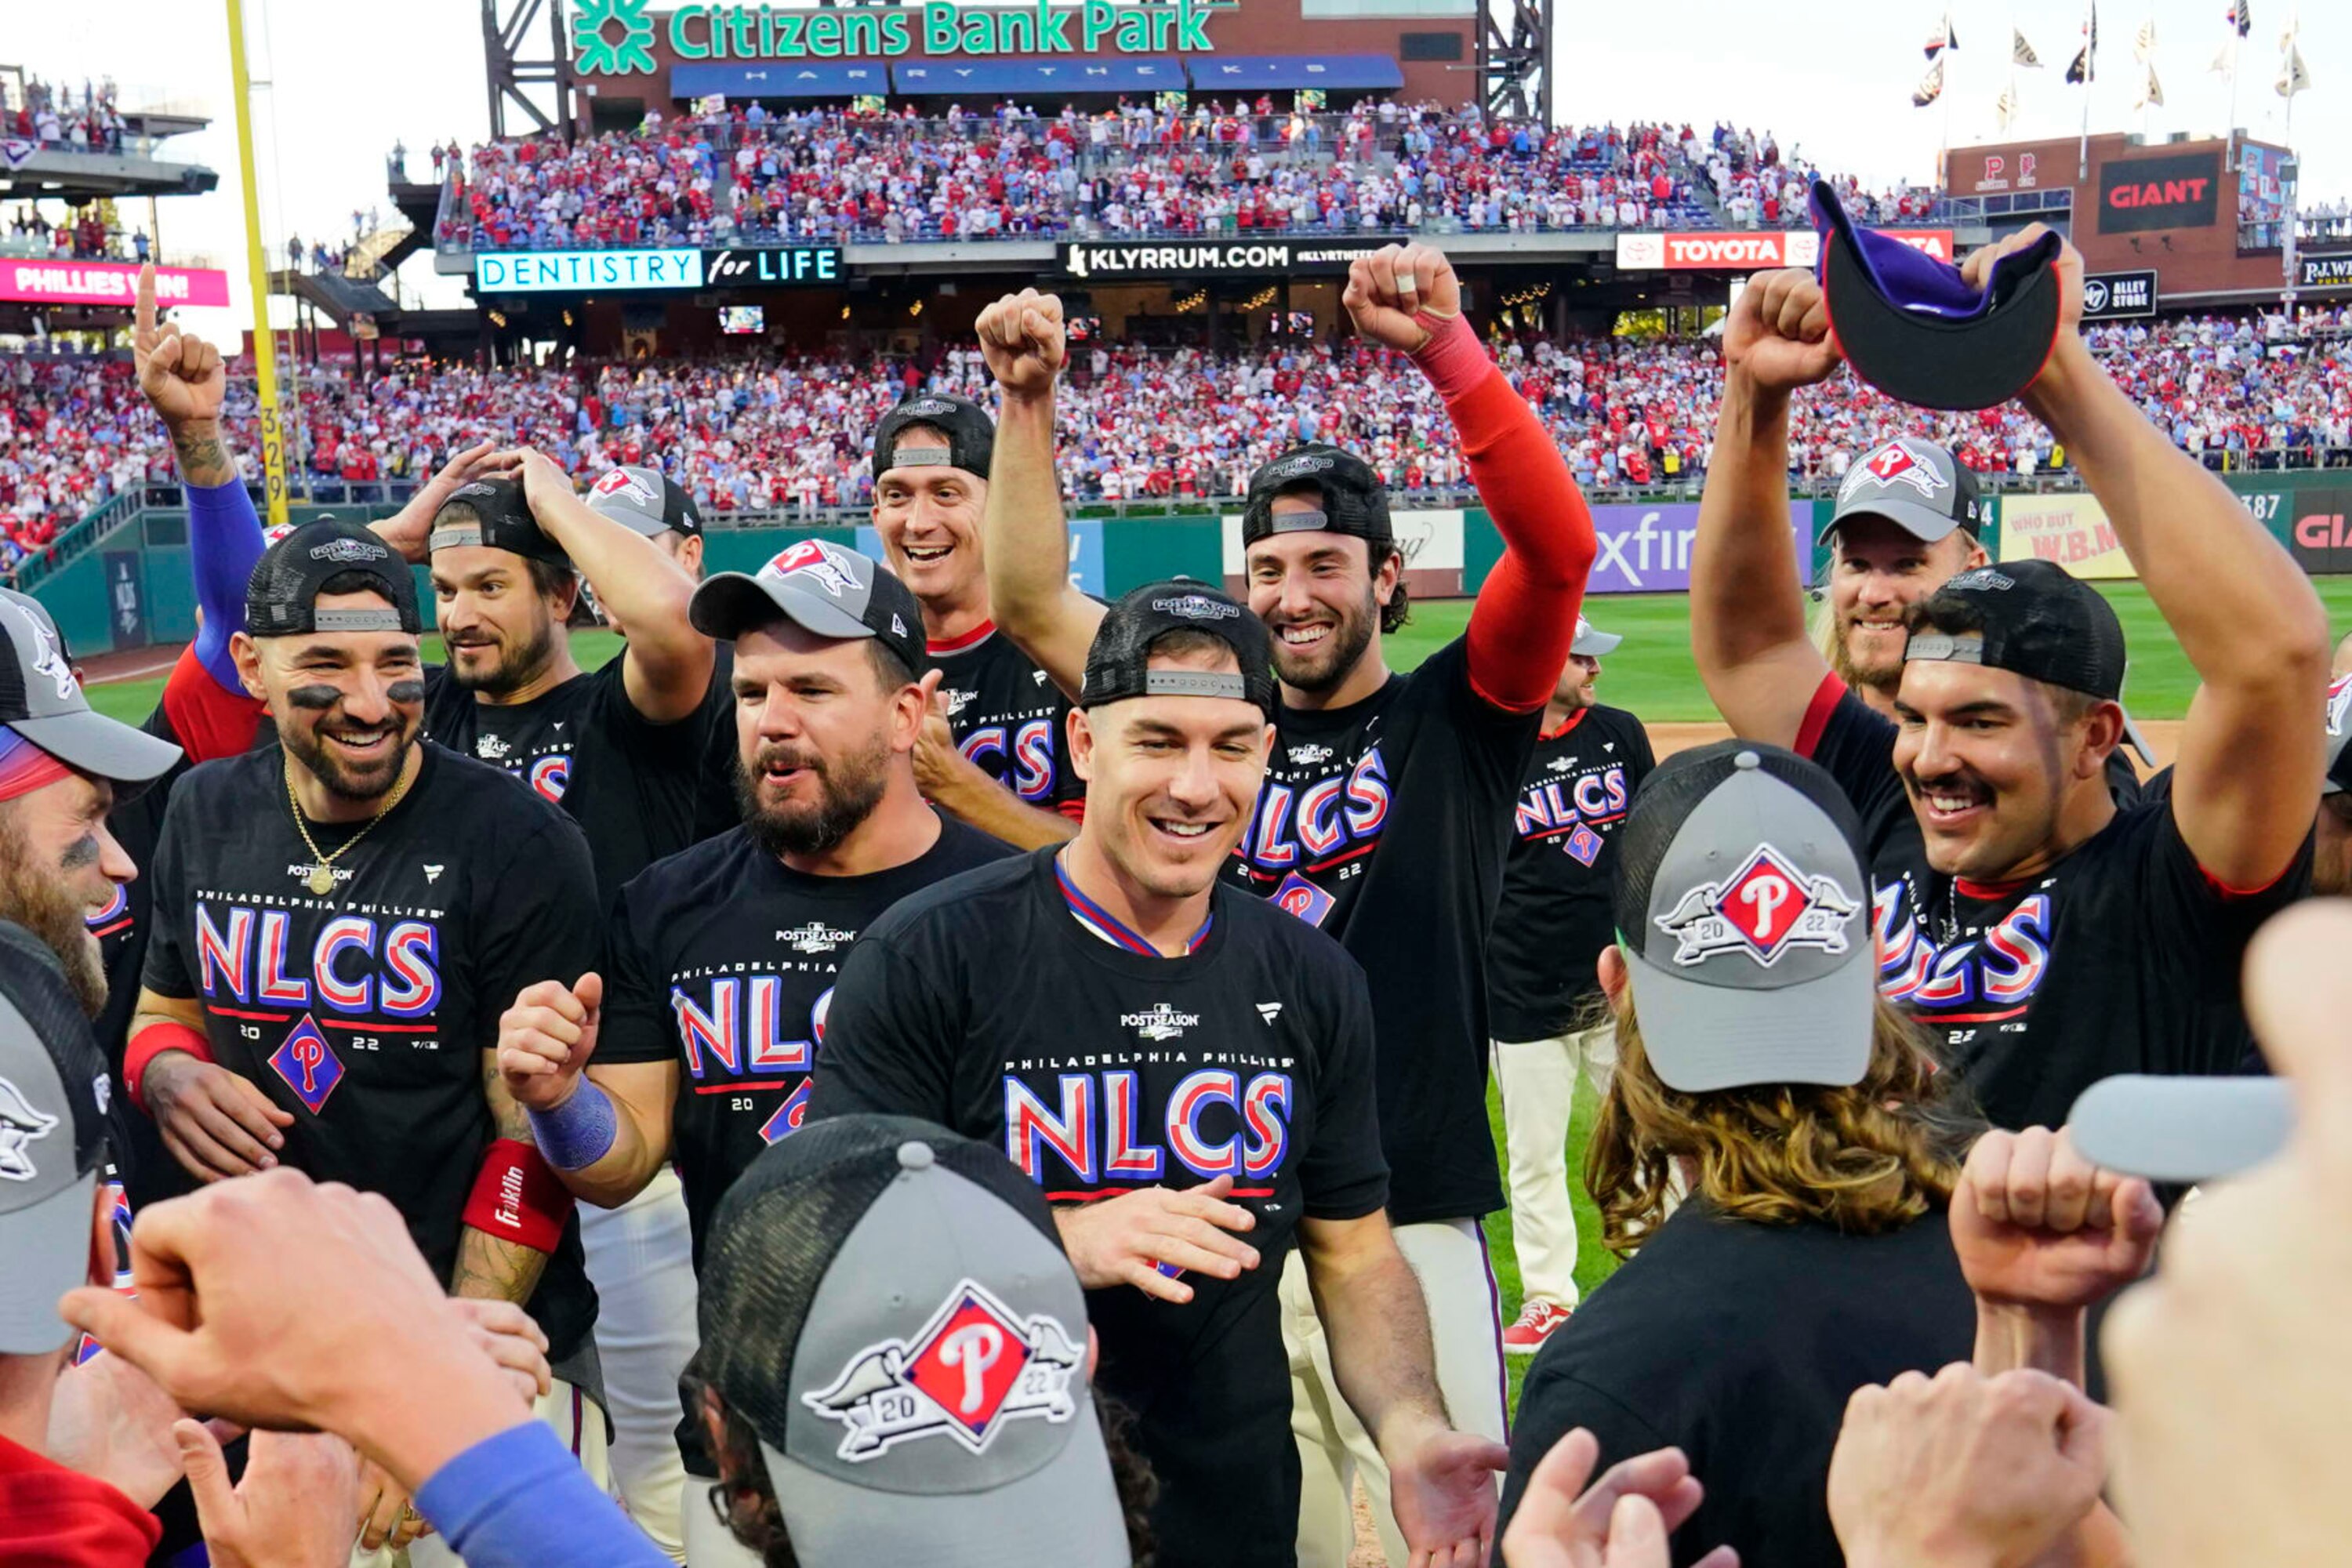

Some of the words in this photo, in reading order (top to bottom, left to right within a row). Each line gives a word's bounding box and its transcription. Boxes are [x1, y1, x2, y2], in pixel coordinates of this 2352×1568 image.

[668, 2, 911, 59] Citizens
[924, 0, 1073, 55] Bank
[1083, 0, 1214, 53] Park
[746, 68, 975, 80] HARRY
[1037, 66, 1155, 76] THE
[2109, 178, 2209, 209] GIANT
[1091, 246, 1289, 270] KLYRRUM.COM
[1669, 239, 1779, 262] TOYOTA
[483, 254, 691, 286] DENTISTRY
[708, 250, 752, 284] for
[758, 250, 837, 281] LIFE
[15, 267, 126, 296] PHILLIES
[2113, 279, 2147, 295] ALLEY
[2112, 293, 2148, 308] STORE
[2011, 515, 2044, 532] WHO
[2047, 512, 2074, 528] BUT
[979, 707, 1055, 724] PHILLIES
[1515, 768, 1628, 836] NLCS
[1339, 862, 1362, 880] 22
[197, 890, 336, 911] PHILADELPHIA
[347, 902, 444, 919] PHILLIES
[1740, 874, 1789, 939] P
[1700, 922, 1724, 940] 20
[1805, 916, 1826, 932] 22
[775, 930, 855, 942] POSTSEASON
[196, 901, 443, 1018] NLCS
[671, 961, 837, 983] PHILADELPHIA
[240, 1024, 261, 1040] 20
[670, 975, 835, 1079] NL
[1120, 1014, 1200, 1027] POSTSEASON
[352, 1036, 380, 1051] 22
[292, 1036, 325, 1093] P
[1004, 1052, 1187, 1072] PHILADELPHIA
[1203, 1051, 1294, 1069] PHILLIES
[731, 1098, 753, 1111] 20
[1003, 1068, 1293, 1185] NLCS
[938, 1322, 1004, 1415] P
[1023, 1370, 1047, 1396] 22
[880, 1396, 916, 1423] 20
